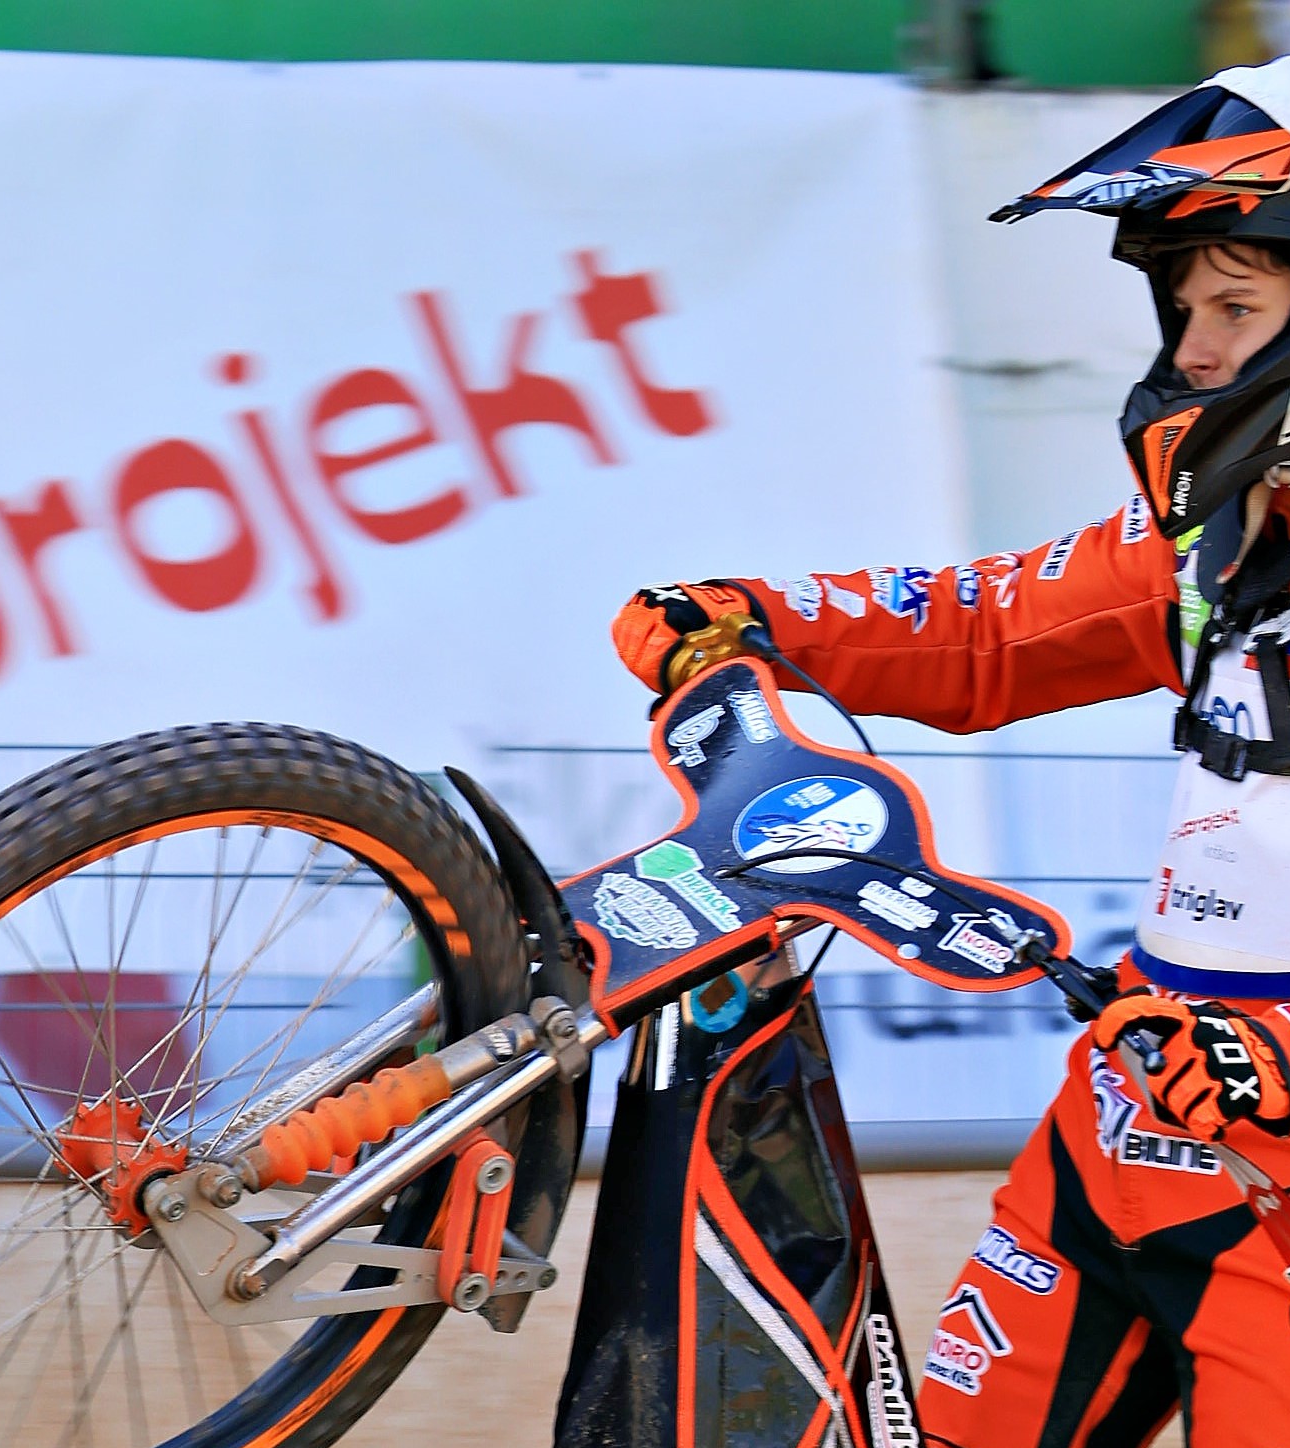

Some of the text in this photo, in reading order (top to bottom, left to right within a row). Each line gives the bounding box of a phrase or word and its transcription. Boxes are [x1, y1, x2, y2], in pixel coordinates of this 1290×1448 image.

[1172, 471, 1193, 517] AIROH
[1172, 882, 1245, 921] triglav
[1198, 1015, 1261, 1102] FOX
